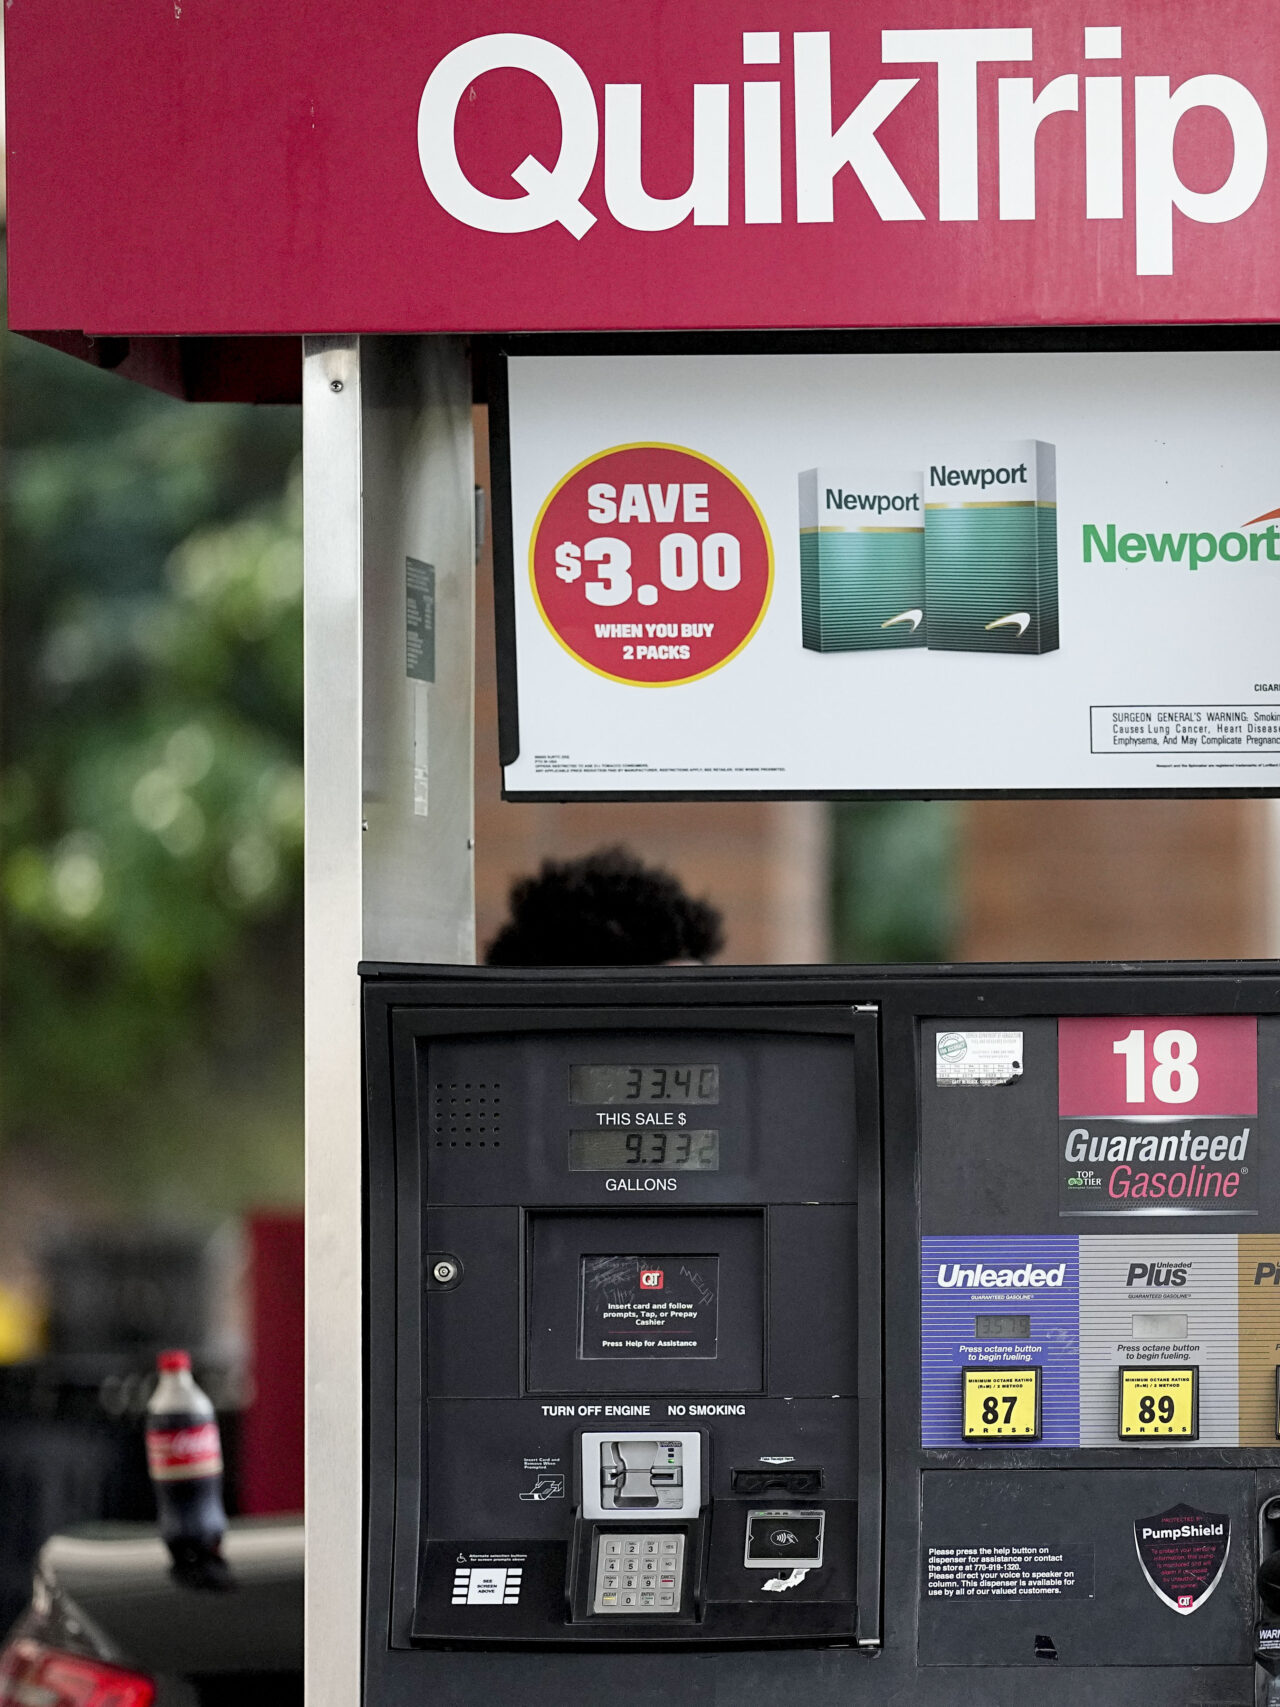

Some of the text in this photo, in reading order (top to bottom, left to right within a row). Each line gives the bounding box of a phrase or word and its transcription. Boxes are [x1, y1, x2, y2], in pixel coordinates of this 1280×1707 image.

[417, 25, 1268, 276] QuikTrip
[929, 463, 1028, 489] Newport
[587, 483, 709, 524] SAVE
[825, 488, 920, 516] Newport
[1082, 523, 1280, 571] Newport
[555, 532, 741, 606] $3.00
[594, 623, 714, 638] WHEN YOU BUY
[623, 645, 690, 659] 2 PACKS
[1112, 712, 1151, 722] SURGEON
[1158, 712, 1201, 722] GENERAL'S
[1207, 712, 1248, 722] WARNING:
[1113, 724, 1144, 733] Causes
[1148, 724, 1170, 735] Lung
[1176, 724, 1211, 734] Cancer,
[1217, 724, 1242, 733] Heart
[1113, 736, 1159, 746] Emphysema,
[1163, 735, 1177, 744] And
[1181, 735, 1197, 746] May
[1201, 735, 1242, 746] Complicate
[1113, 1030, 1199, 1104] 18
[596, 1112, 687, 1126] THIS SALE $
[1065, 1128, 1250, 1162] Guaranteed
[606, 1179, 677, 1191] GALLONS
[1083, 1178, 1101, 1186] TIER
[642, 1272, 660, 1286] QT
[937, 1264, 1066, 1287] Unleaded
[1126, 1263, 1187, 1286] Plus
[603, 1311, 638, 1319] prompts,
[979, 1353, 1001, 1362] begin
[1003, 1353, 1033, 1362] fueling.
[1137, 1352, 1159, 1361] begin
[1161, 1352, 1191, 1360] fueling.
[542, 1406, 650, 1416] TURN OFF ENGINE
[668, 1405, 746, 1415] NO SMOKING
[982, 1396, 1017, 1424] 87
[1139, 1396, 1174, 1423] 89
[1142, 1524, 1223, 1540] PumpShield
[928, 1556, 967, 1564] dispenser
[1032, 1571, 1062, 1579] speaker
[928, 1580, 959, 1588] column.
[944, 1588, 954, 1596] by
[1019, 1587, 1061, 1595] customers.
[1179, 1597, 1190, 1606] QT
